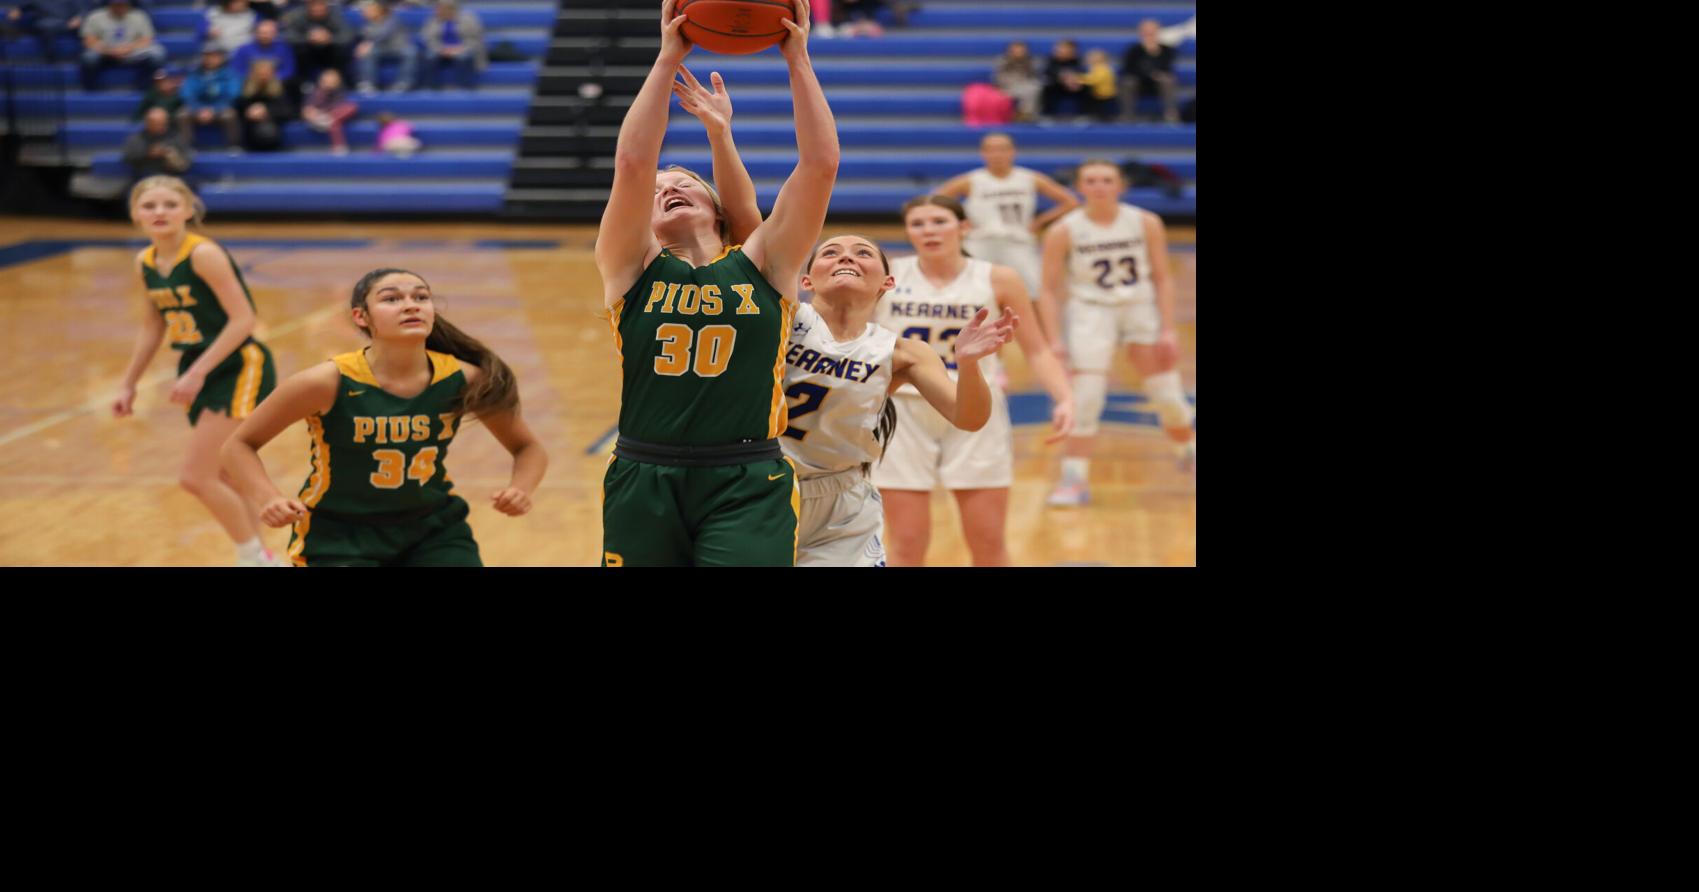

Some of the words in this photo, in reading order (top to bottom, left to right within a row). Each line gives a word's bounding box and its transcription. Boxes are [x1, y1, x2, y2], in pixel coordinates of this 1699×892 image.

[1091, 256, 1138, 289] 23
[731, 283, 760, 315] X
[654, 323, 737, 377] 30
[786, 341, 880, 383] EARNEY
[353, 415, 430, 444] PIUS
[784, 382, 833, 441] 2
[370, 446, 438, 489] 34
